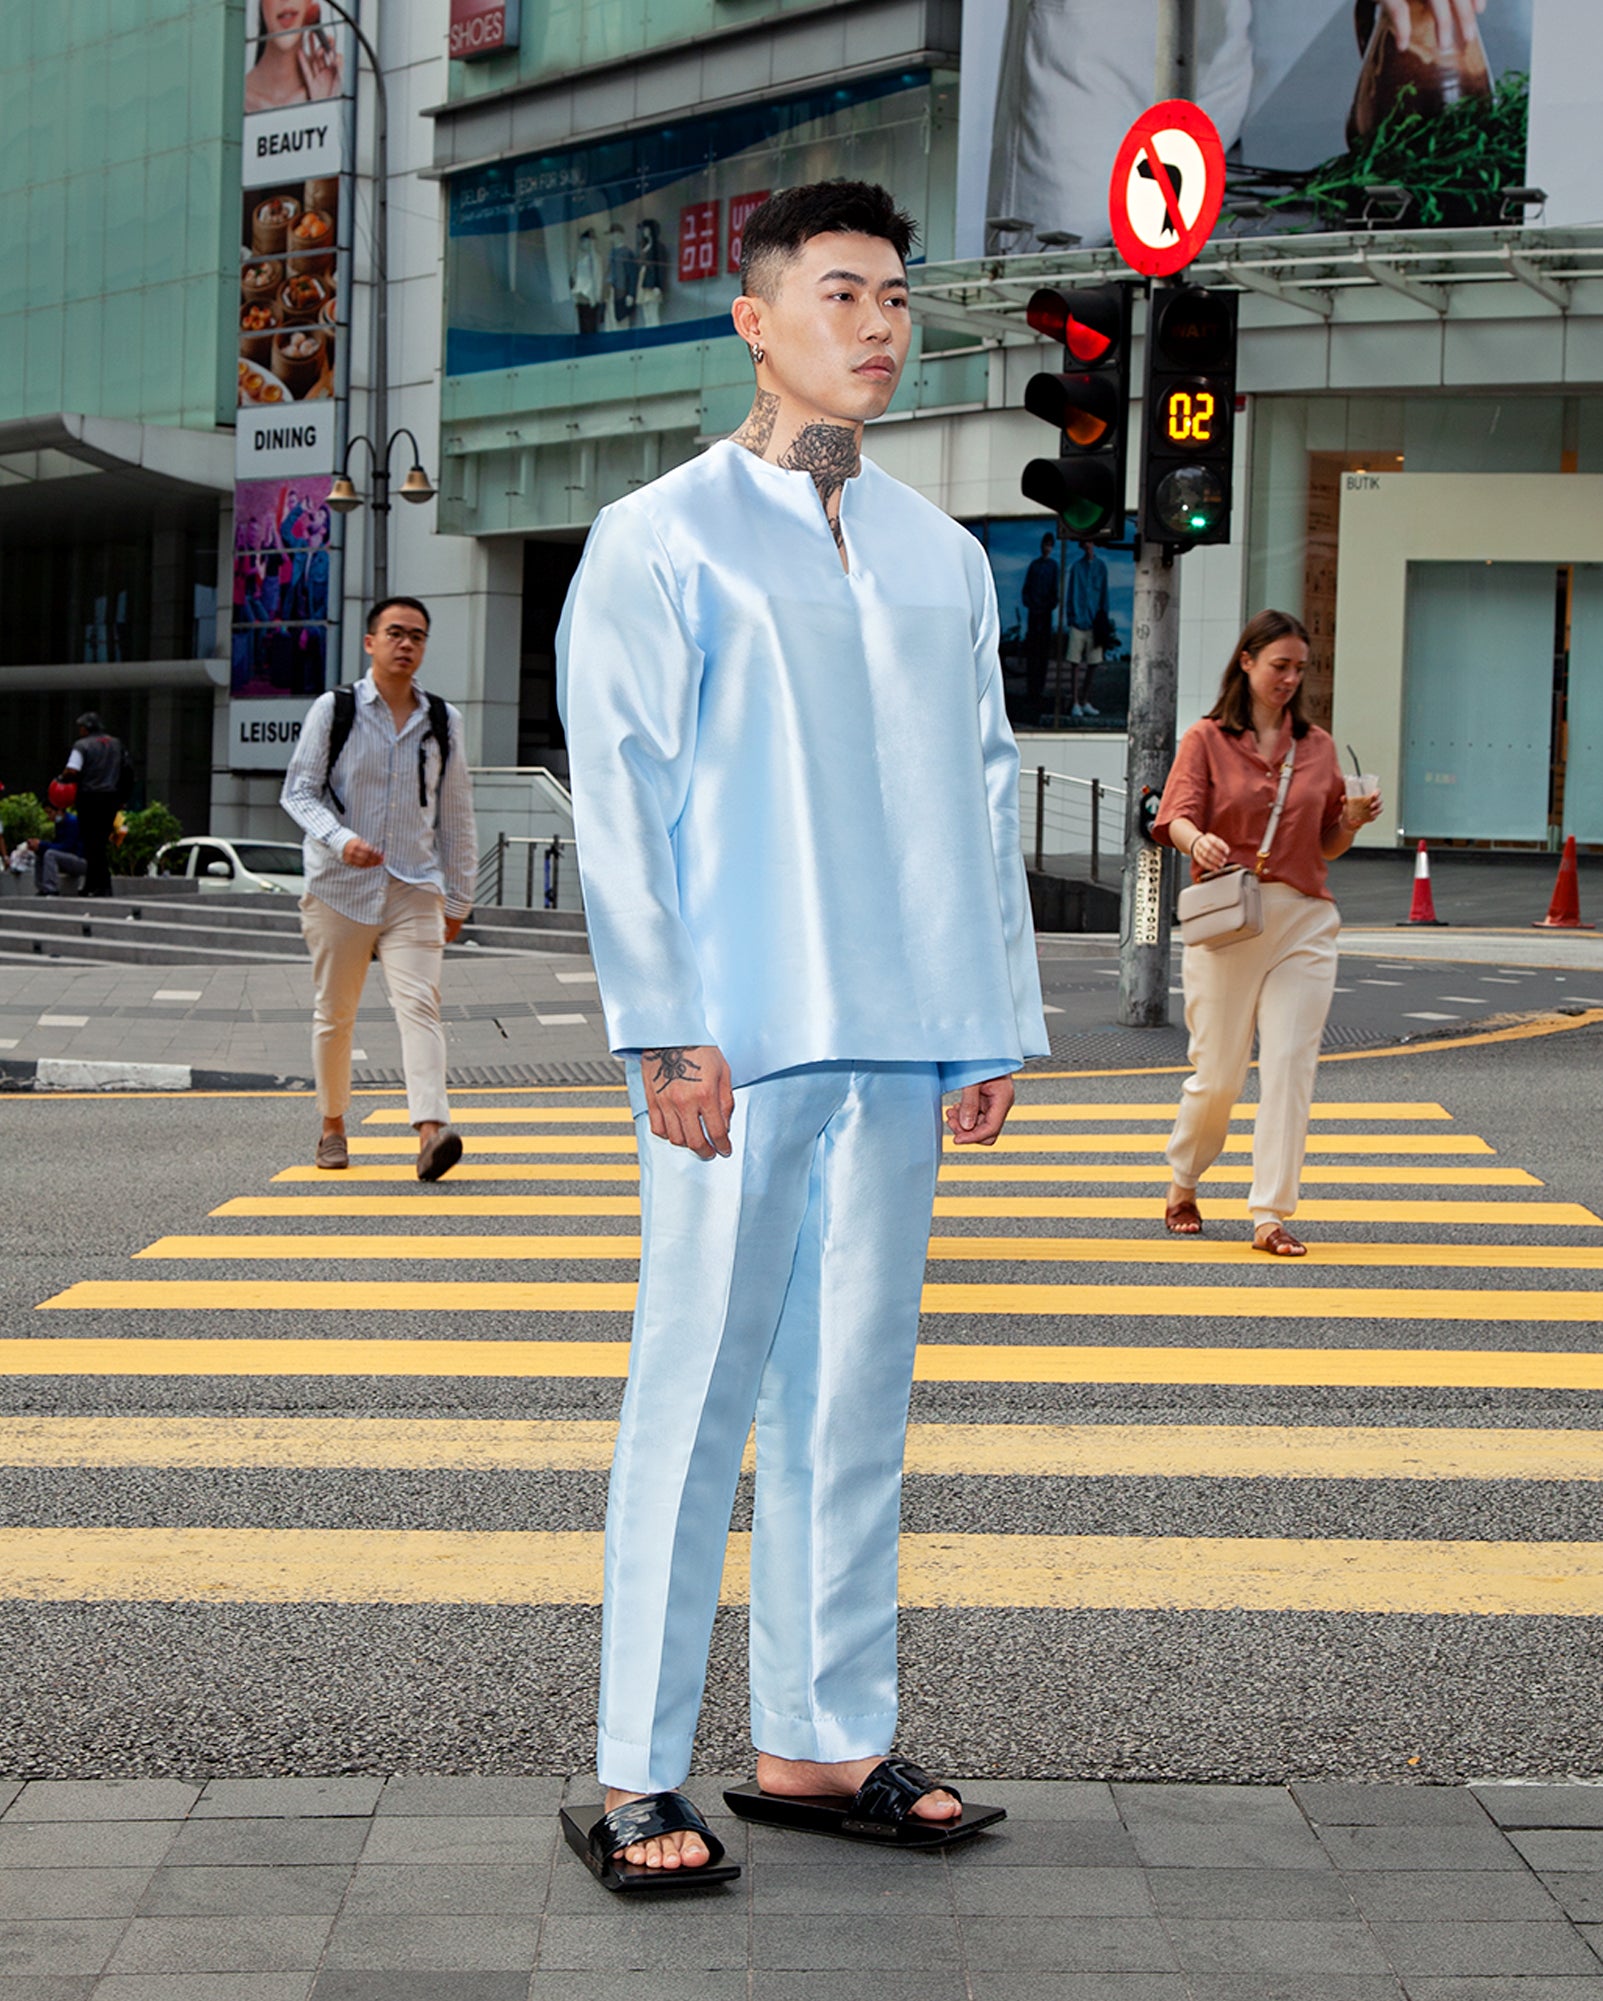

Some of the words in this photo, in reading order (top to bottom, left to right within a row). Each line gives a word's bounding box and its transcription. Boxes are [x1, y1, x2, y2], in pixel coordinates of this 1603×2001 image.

[450, 12, 503, 51] SHOES
[257, 125, 328, 158] BEAUTY
[1169, 393, 1214, 440] 02
[254, 425, 317, 451] DINING
[1347, 476, 1380, 490] BUTIK
[241, 722, 302, 743] LEISUR
